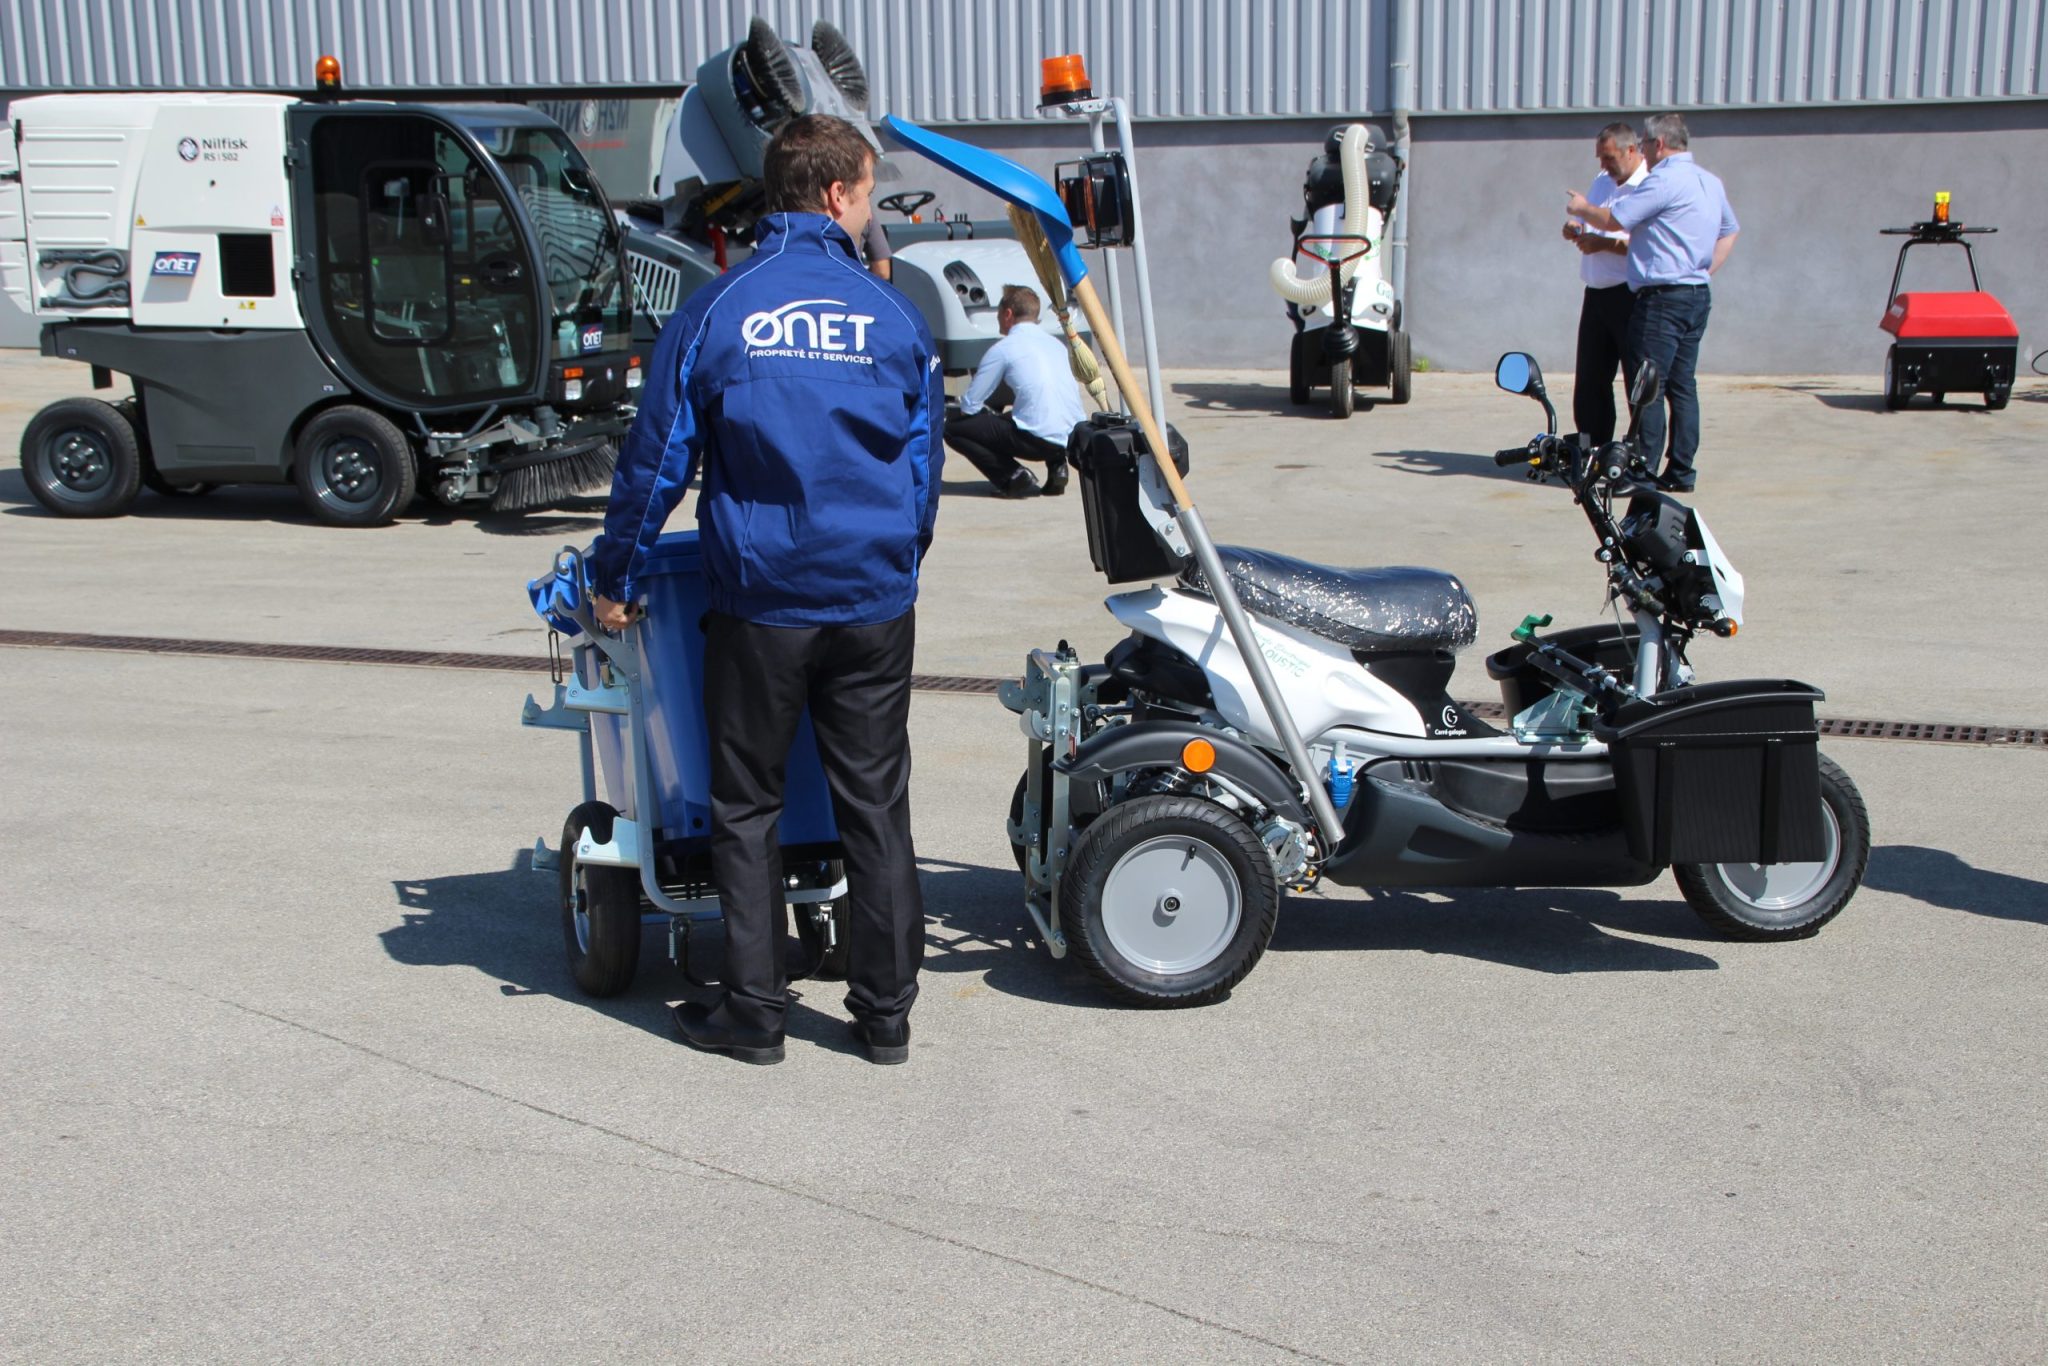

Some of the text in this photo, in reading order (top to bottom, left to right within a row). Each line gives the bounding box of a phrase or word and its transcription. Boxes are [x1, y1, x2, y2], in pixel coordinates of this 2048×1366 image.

[202, 137, 248, 149] Nilfisk
[204, 152, 238, 161] RS 502
[155, 258, 197, 270] ONET
[742, 309, 875, 352] ONET
[583, 331, 602, 346] ONET
[750, 349, 873, 364] PROPRETÉ ET SERVICES
